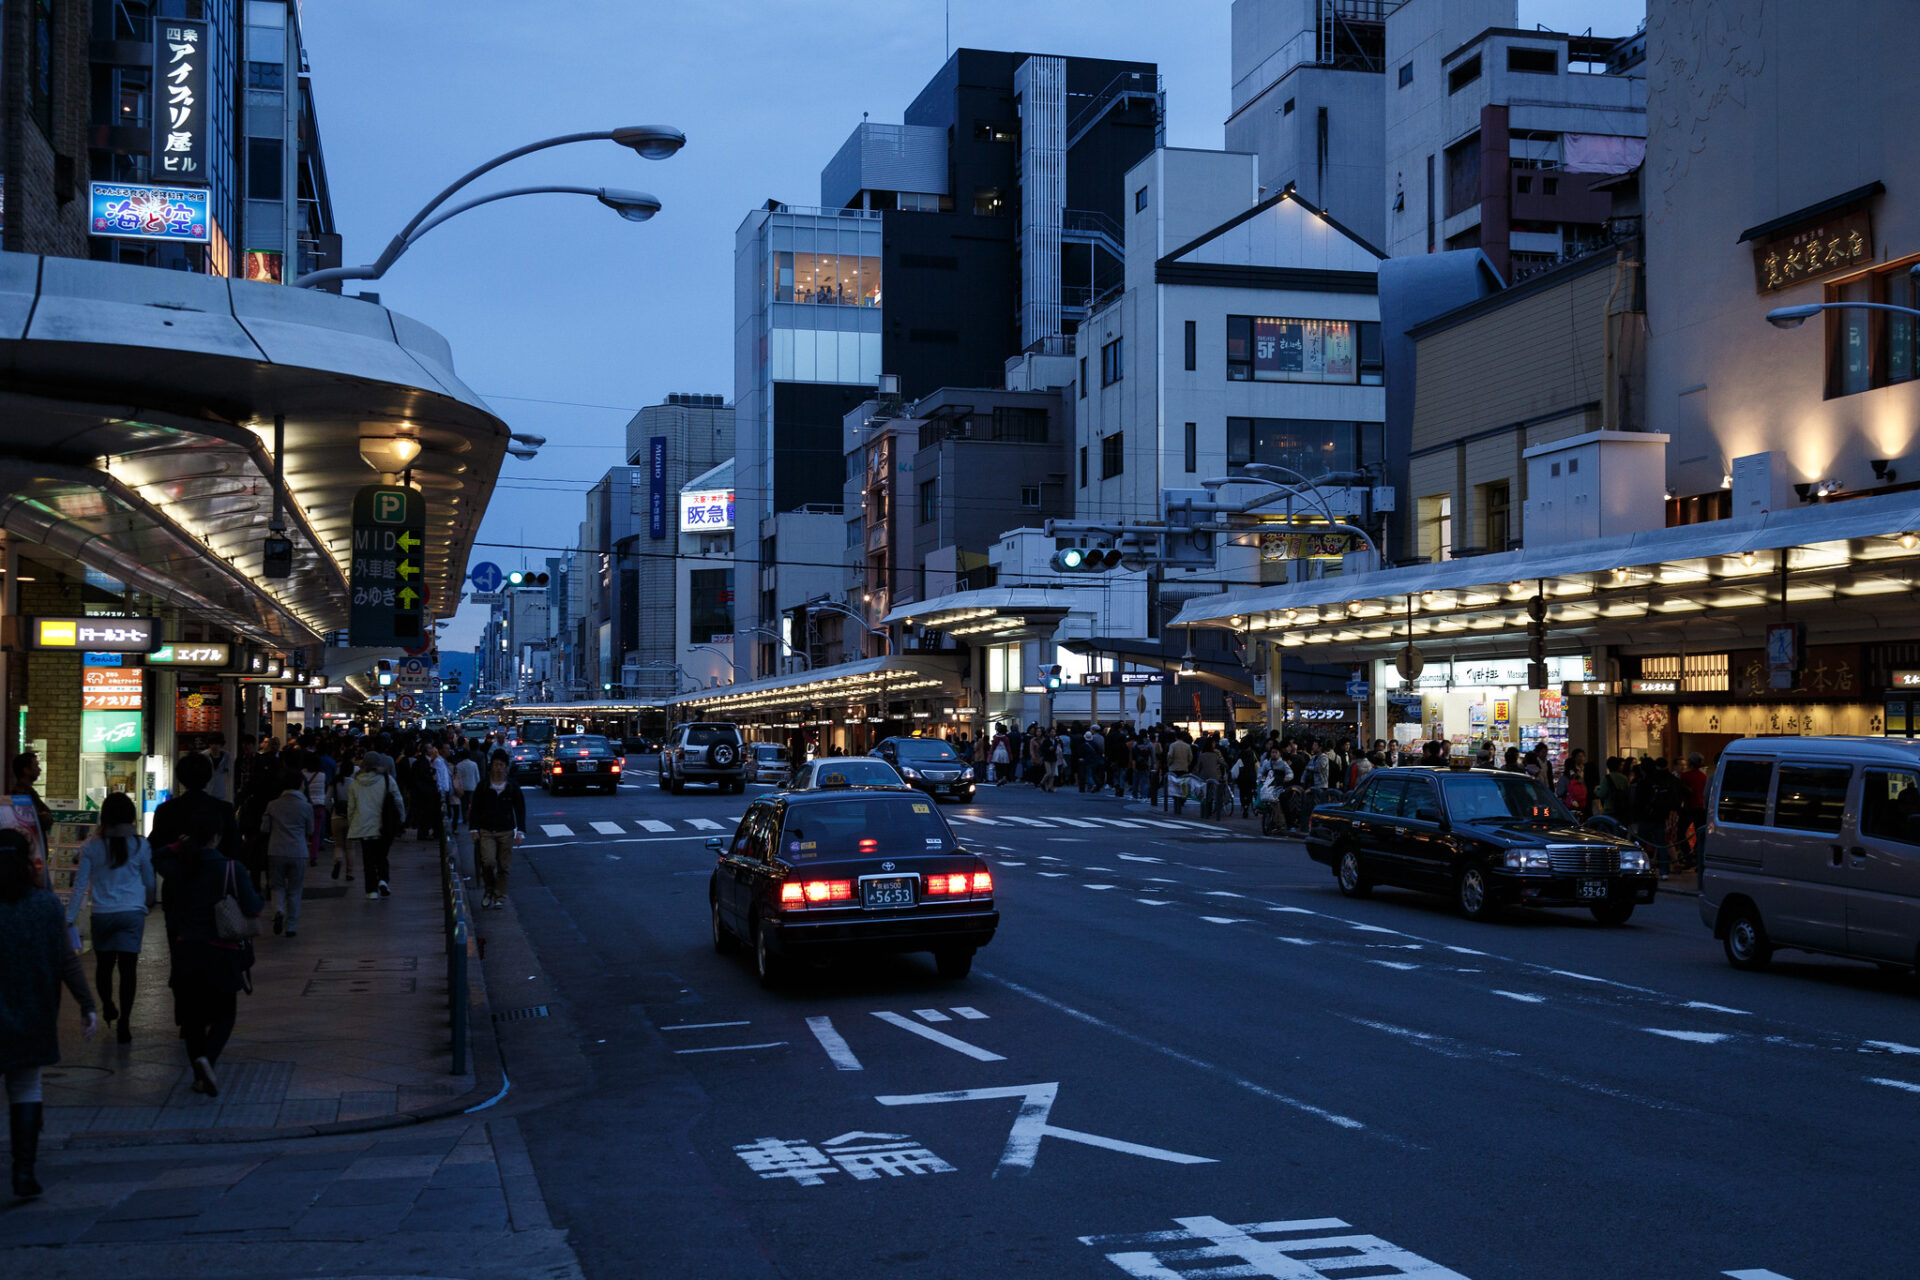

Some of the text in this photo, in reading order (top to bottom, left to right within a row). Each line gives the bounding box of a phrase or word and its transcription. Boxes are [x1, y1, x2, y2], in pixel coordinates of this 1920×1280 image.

[166, 27, 198, 42] 四条
[163, 156, 198, 173] ビル
[105, 200, 195, 234] 海と空
[1257, 341, 1276, 360] 5F
[654, 444, 663, 479] MIZUHO
[354, 529, 397, 551] MID
[354, 558, 397, 579] 外車館
[353, 586, 396, 607] みゆき
[78, 627, 148, 643] ドトールコーヒー
[177, 648, 222, 662] エイブル
[1745, 659, 1855, 697] 寛本店
[87, 721, 137, 743] エイブル
